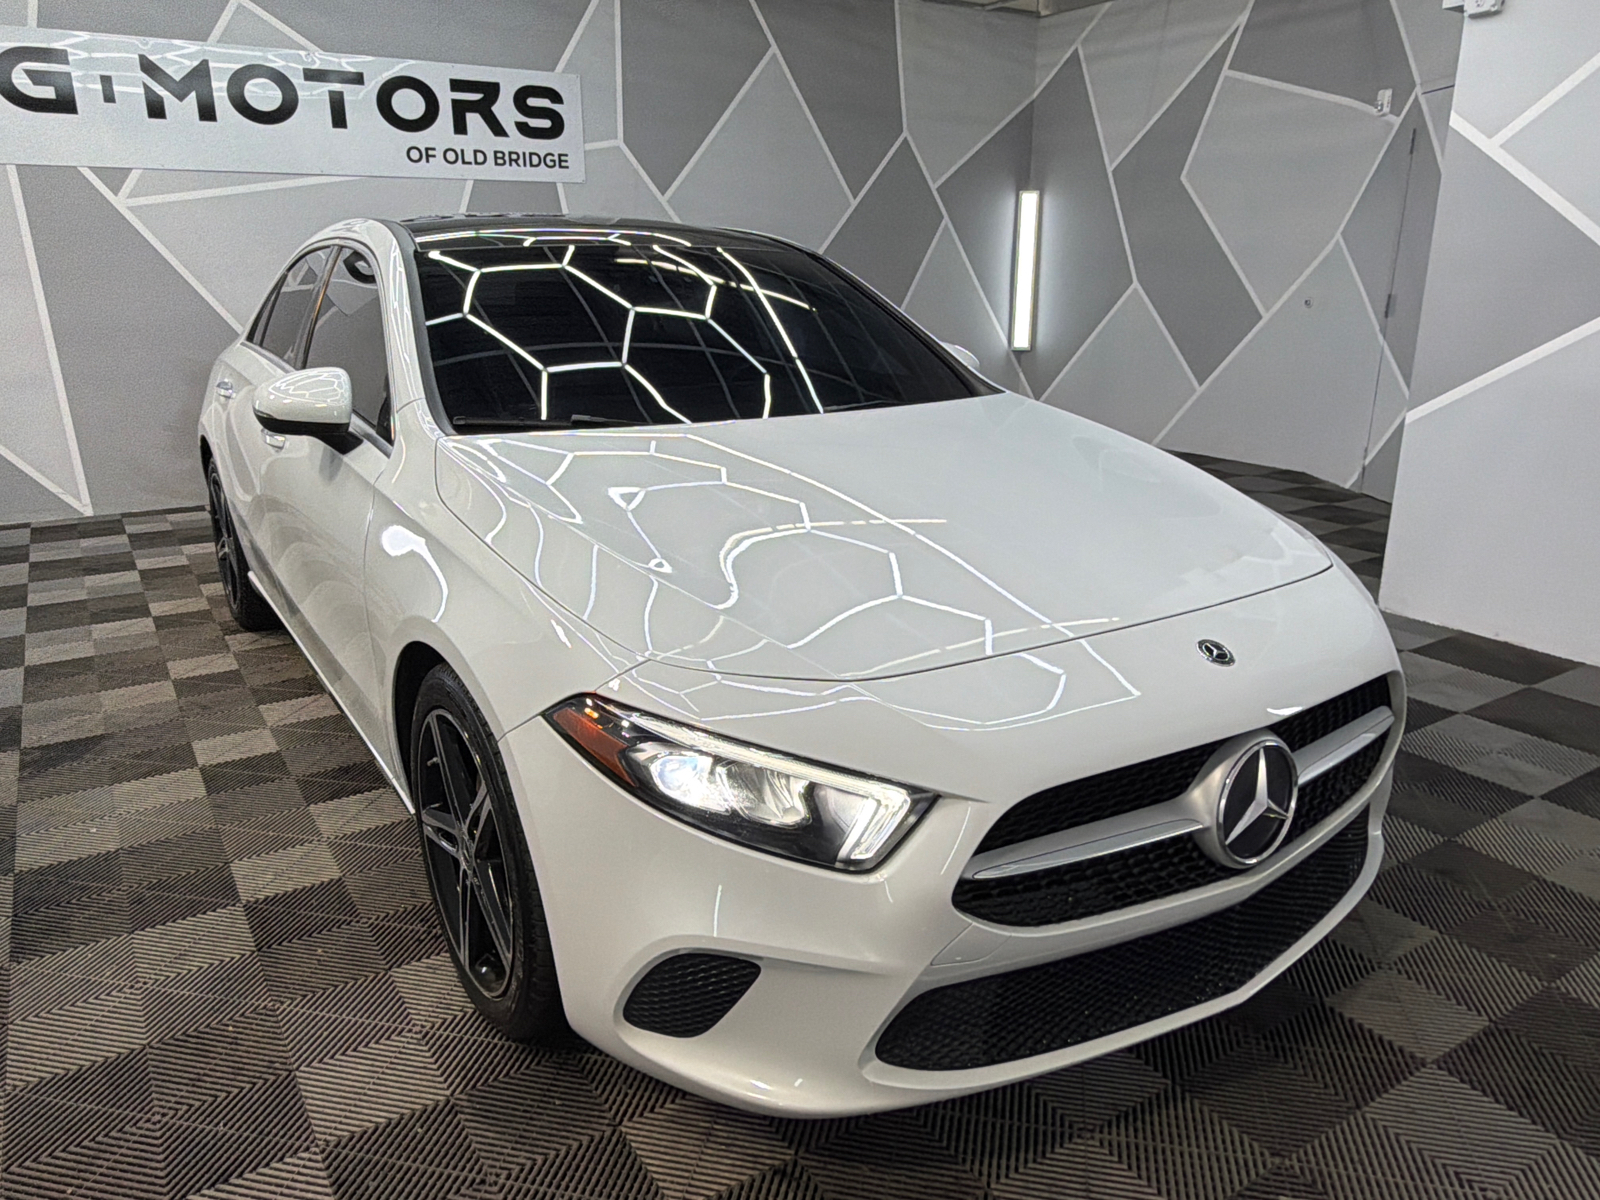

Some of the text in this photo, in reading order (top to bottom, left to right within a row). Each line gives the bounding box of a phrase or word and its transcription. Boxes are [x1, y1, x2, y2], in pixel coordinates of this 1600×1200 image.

[138, 54, 565, 140] MOTORS
[406, 146, 570, 169] OF OLD BRIDGE
